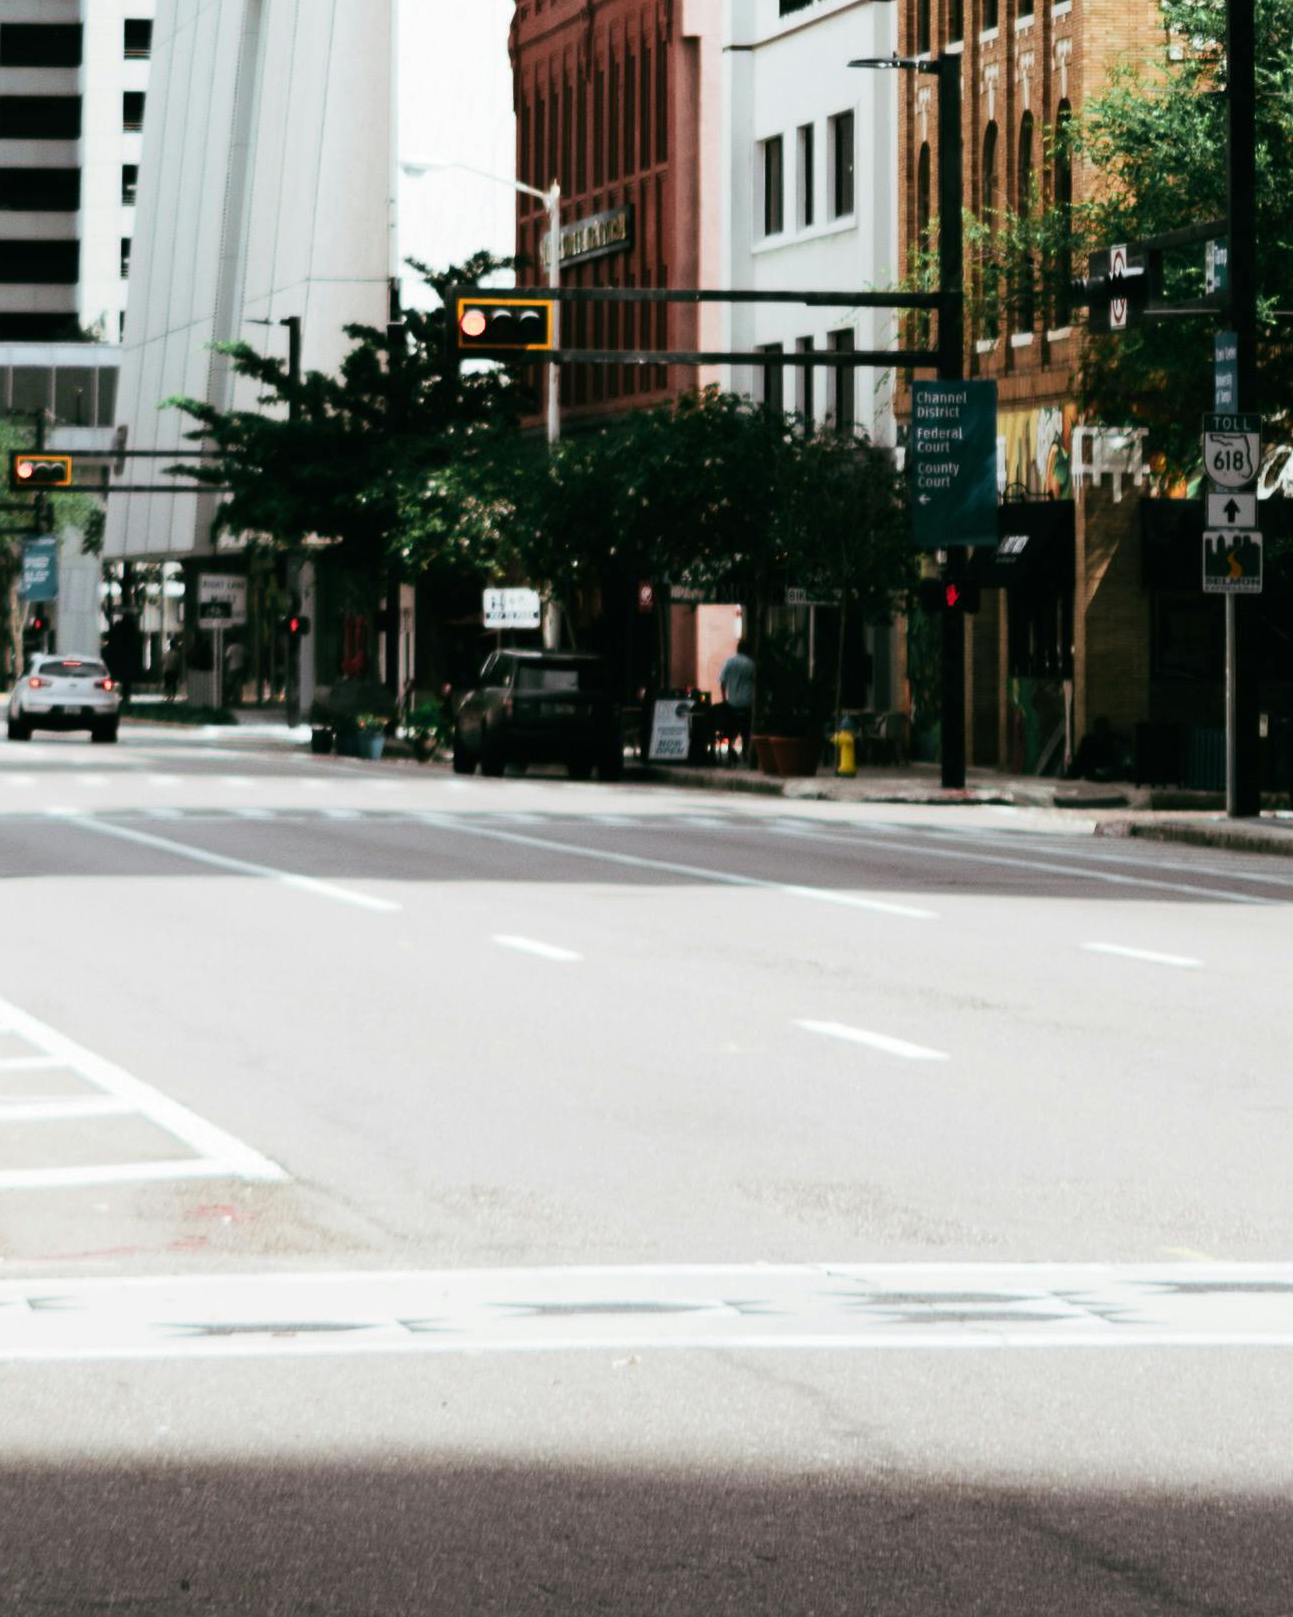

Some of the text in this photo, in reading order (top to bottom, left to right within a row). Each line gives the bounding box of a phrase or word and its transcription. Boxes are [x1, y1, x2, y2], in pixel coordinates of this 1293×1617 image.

[916, 392, 968, 404] Channel
[917, 406, 960, 418] District
[1213, 416, 1252, 431] TOLL
[917, 427, 963, 440] Federal
[917, 441, 950, 453] Court
[1214, 450, 1244, 471] 618
[918, 462, 960, 477] County
[918, 476, 951, 487] Court
